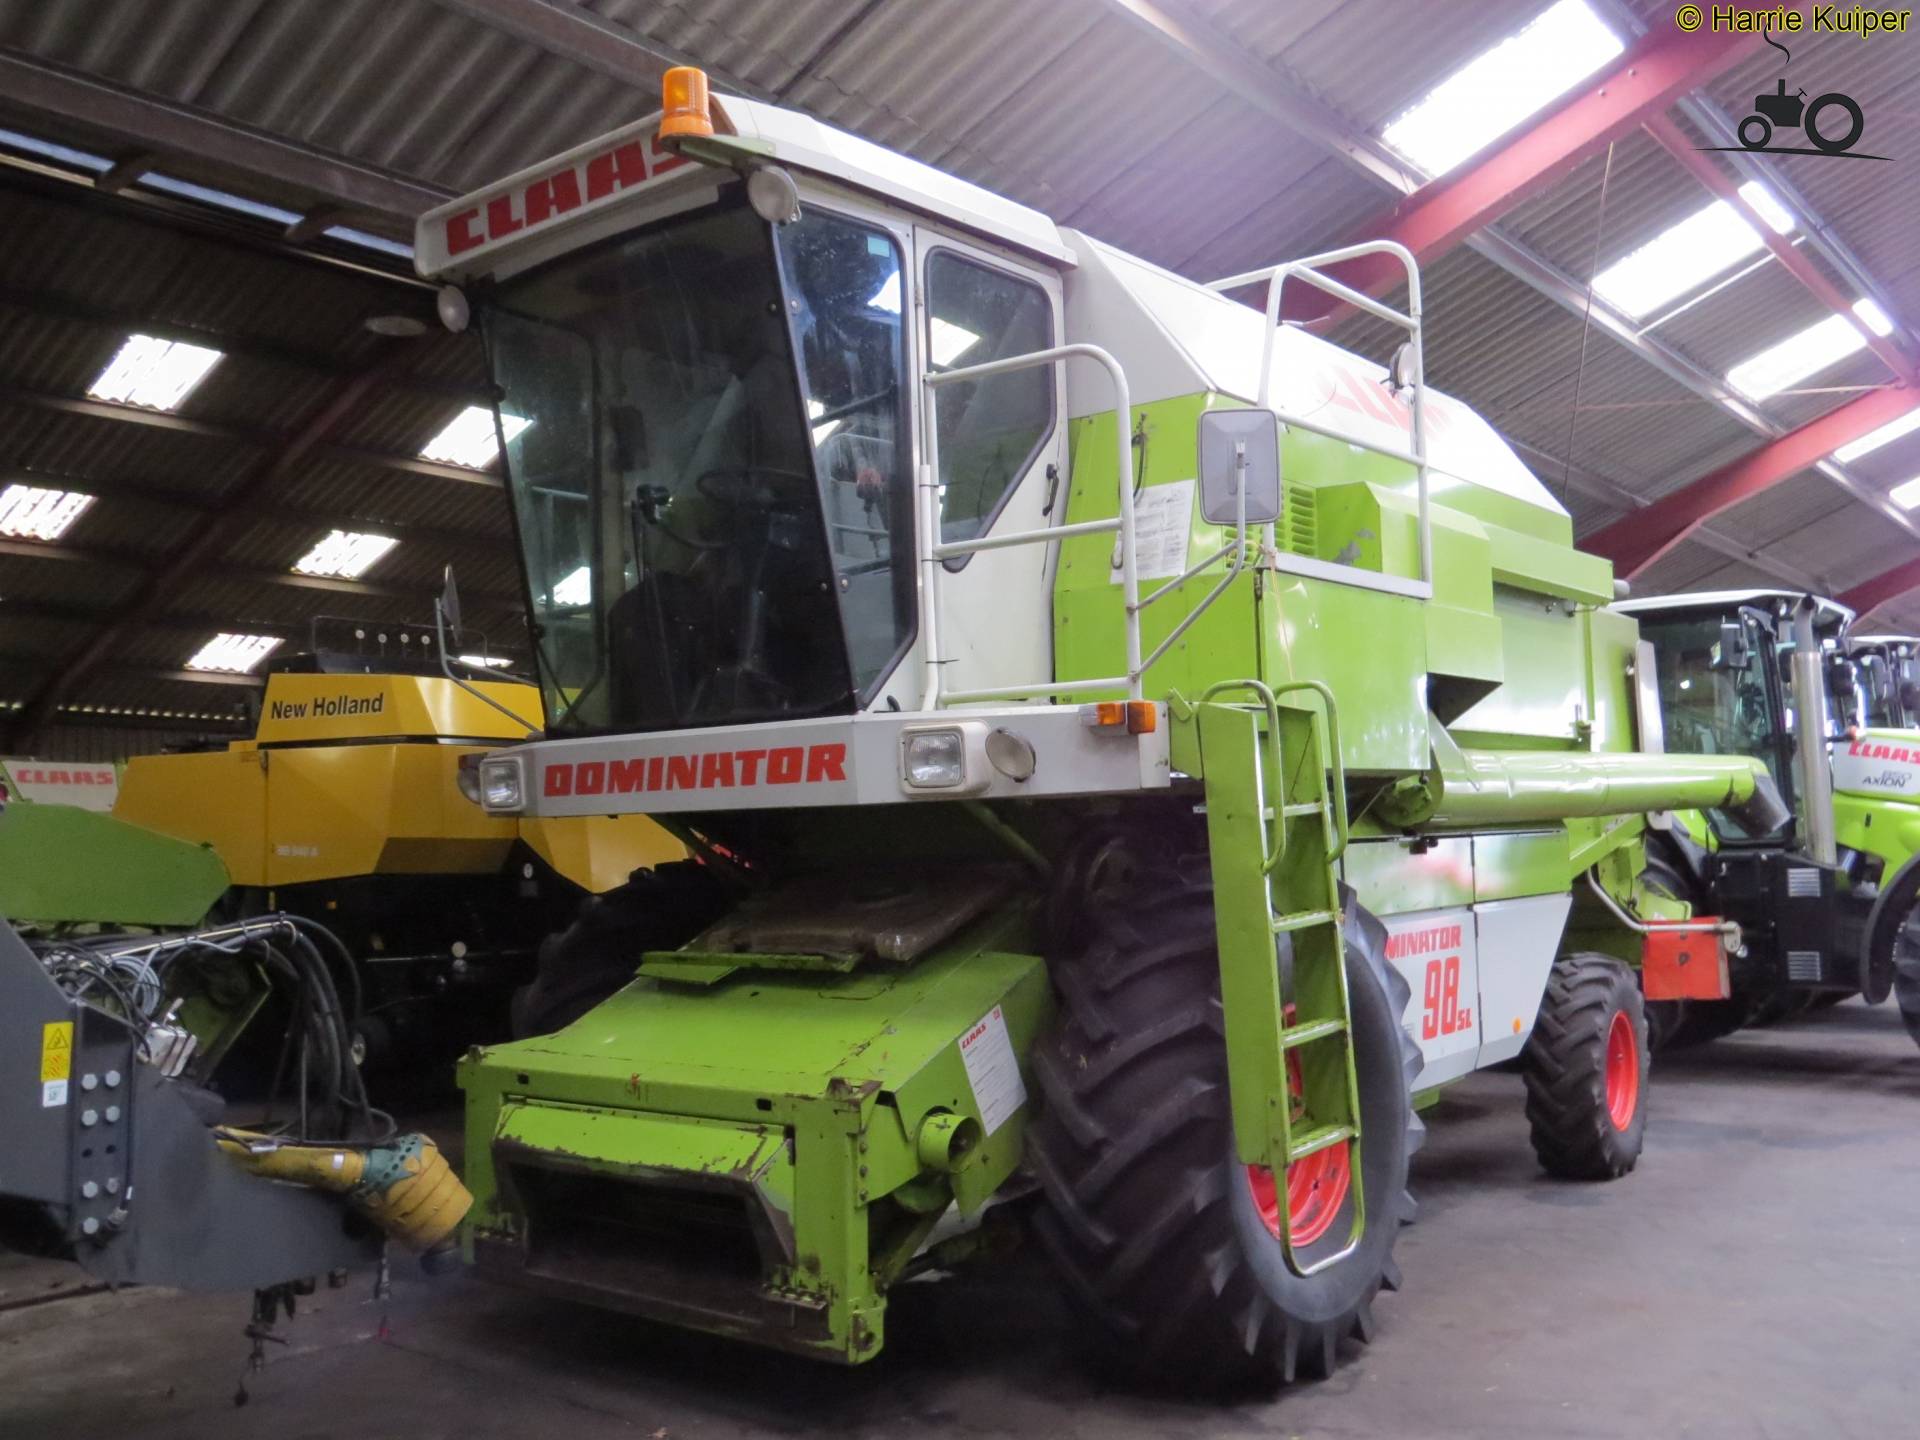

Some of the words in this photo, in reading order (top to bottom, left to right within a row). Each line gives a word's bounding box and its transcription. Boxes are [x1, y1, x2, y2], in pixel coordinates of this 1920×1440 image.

[271, 700, 308, 719] New
[312, 692, 384, 716] Holland
[16, 769, 113, 785] CLAAS
[544, 744, 847, 797] DOMINATOR
[1862, 775, 1906, 788] AXION
[1422, 956, 1460, 1040] 98
[1457, 1008, 1472, 1031] SL
[962, 1023, 987, 1049] CLAAS
